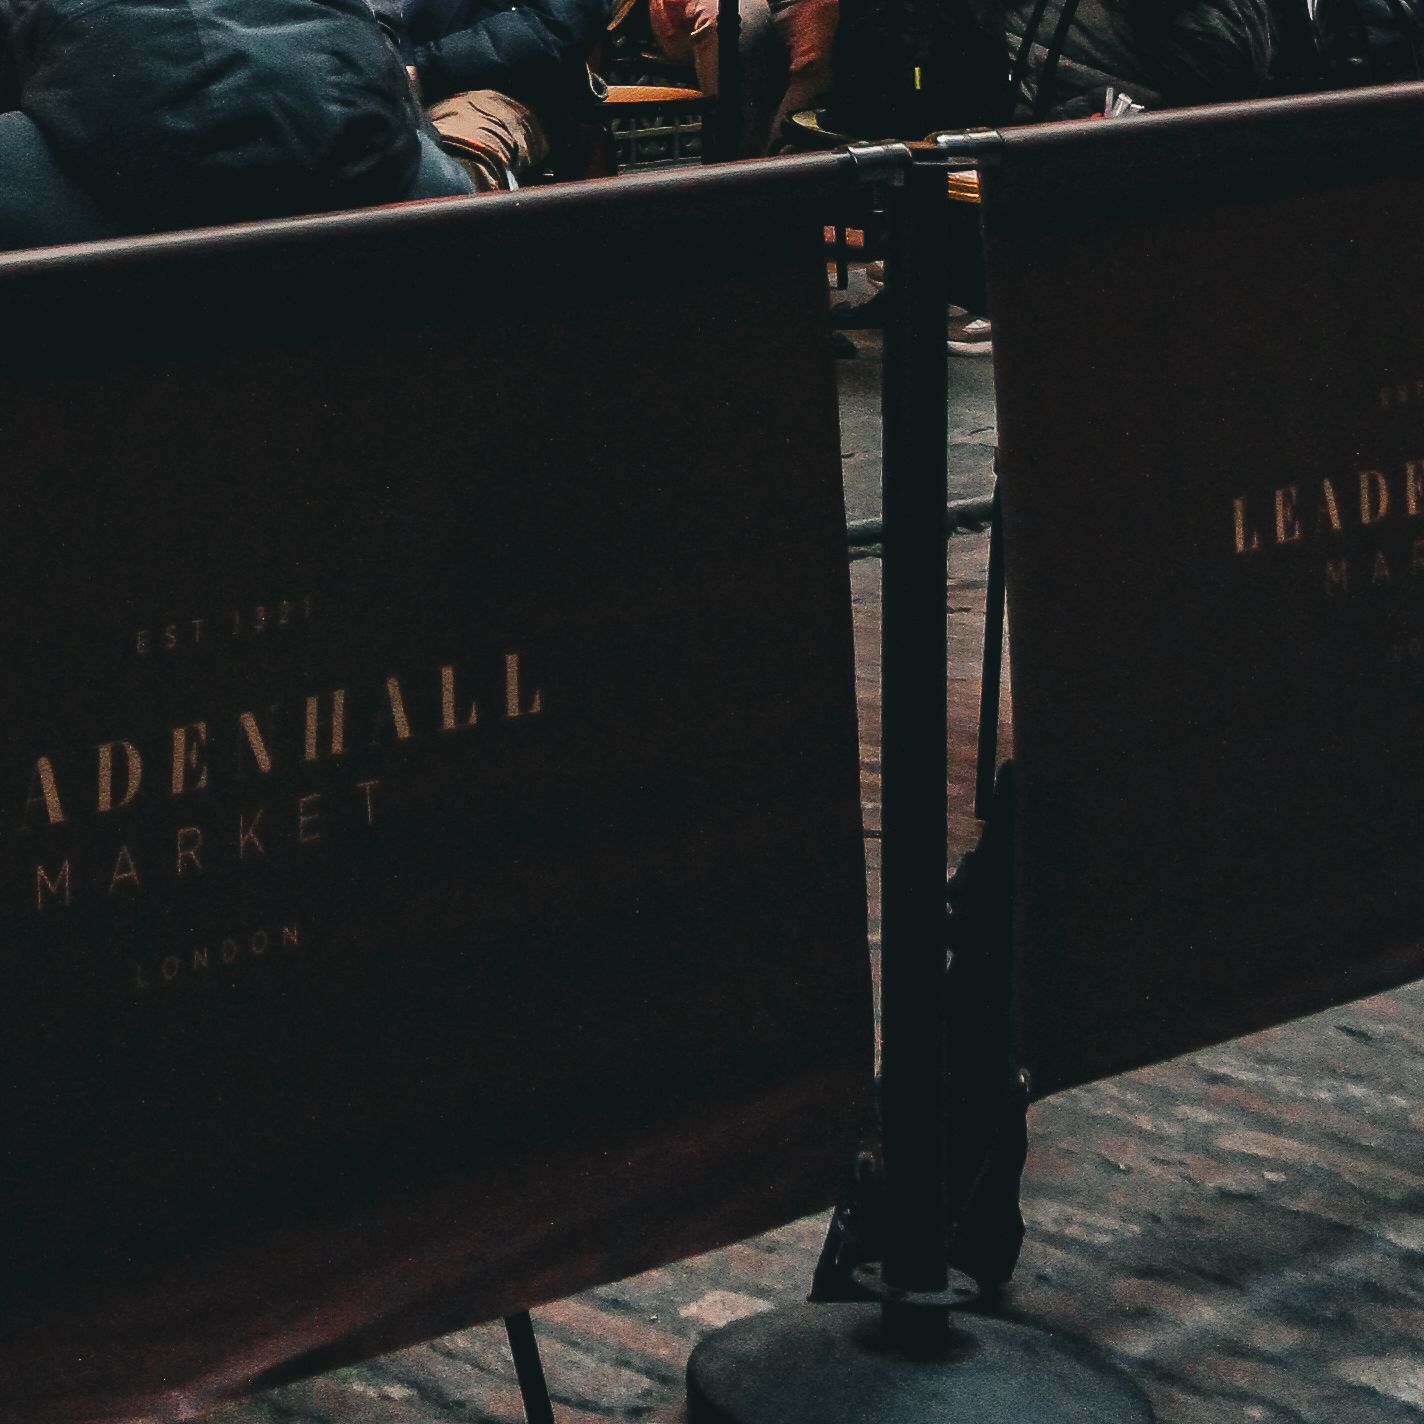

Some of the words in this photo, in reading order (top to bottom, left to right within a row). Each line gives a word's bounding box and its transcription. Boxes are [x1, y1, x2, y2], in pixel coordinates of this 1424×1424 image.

[135, 617, 205, 656] EST
[34, 778, 381, 912] MARKET
[135, 921, 302, 990] LONDON
